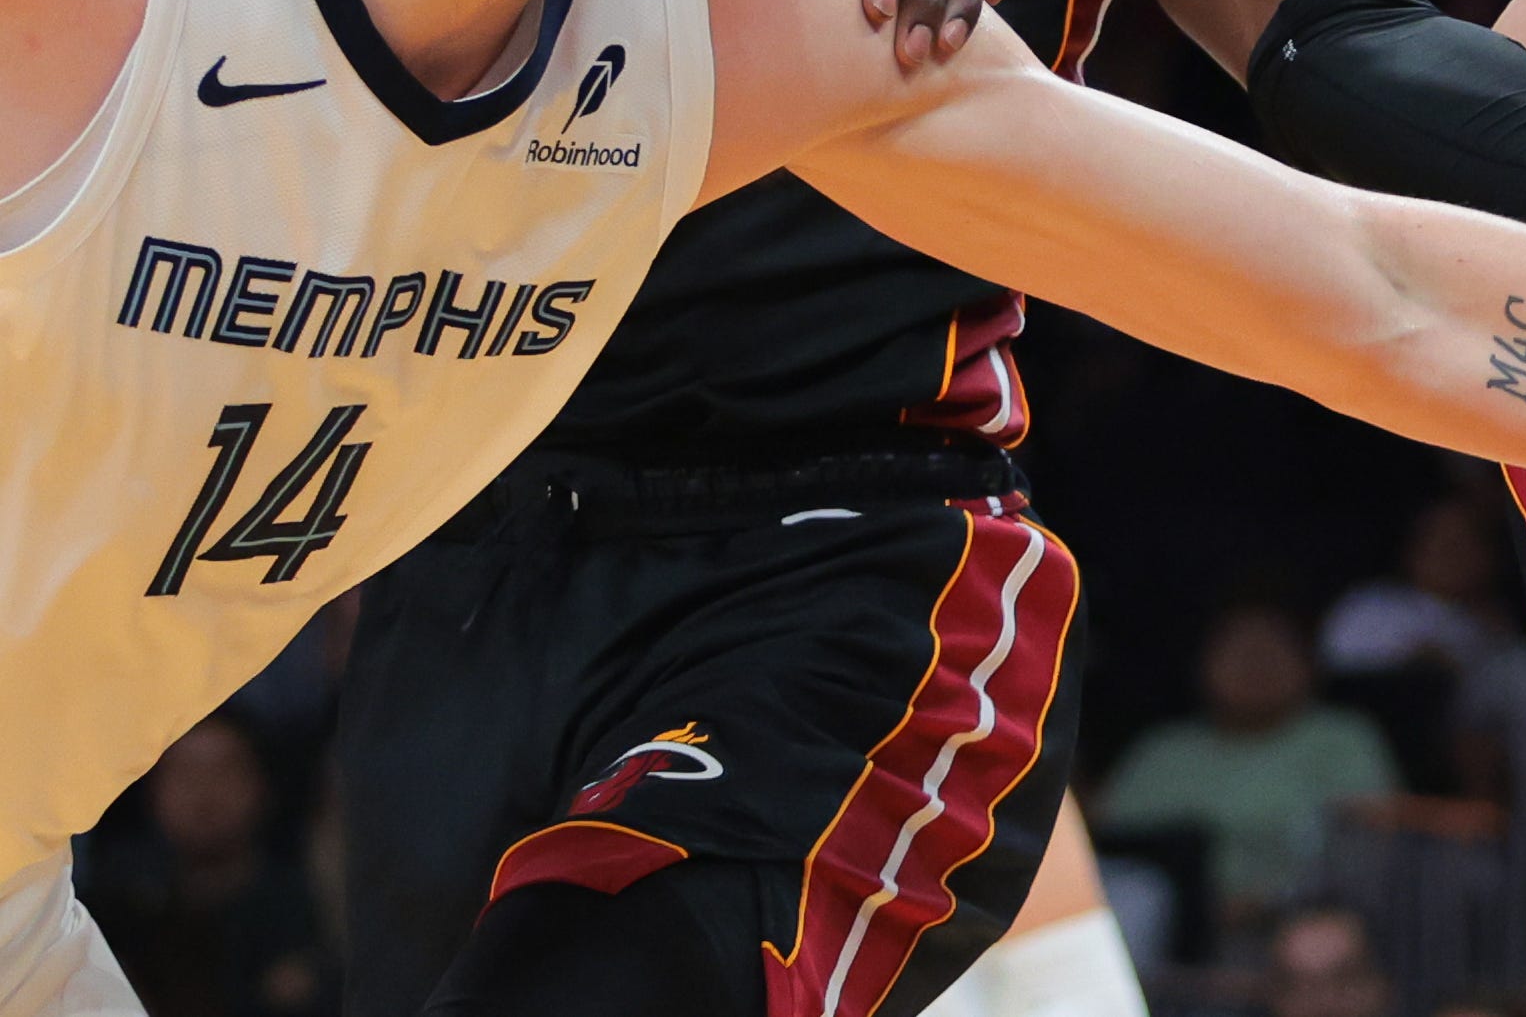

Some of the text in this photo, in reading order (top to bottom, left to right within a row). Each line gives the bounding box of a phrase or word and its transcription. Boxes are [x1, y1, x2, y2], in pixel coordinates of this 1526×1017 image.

[526, 139, 641, 168] Robinhood
[116, 235, 597, 360] MEMPHIS
[144, 402, 373, 597] 14
